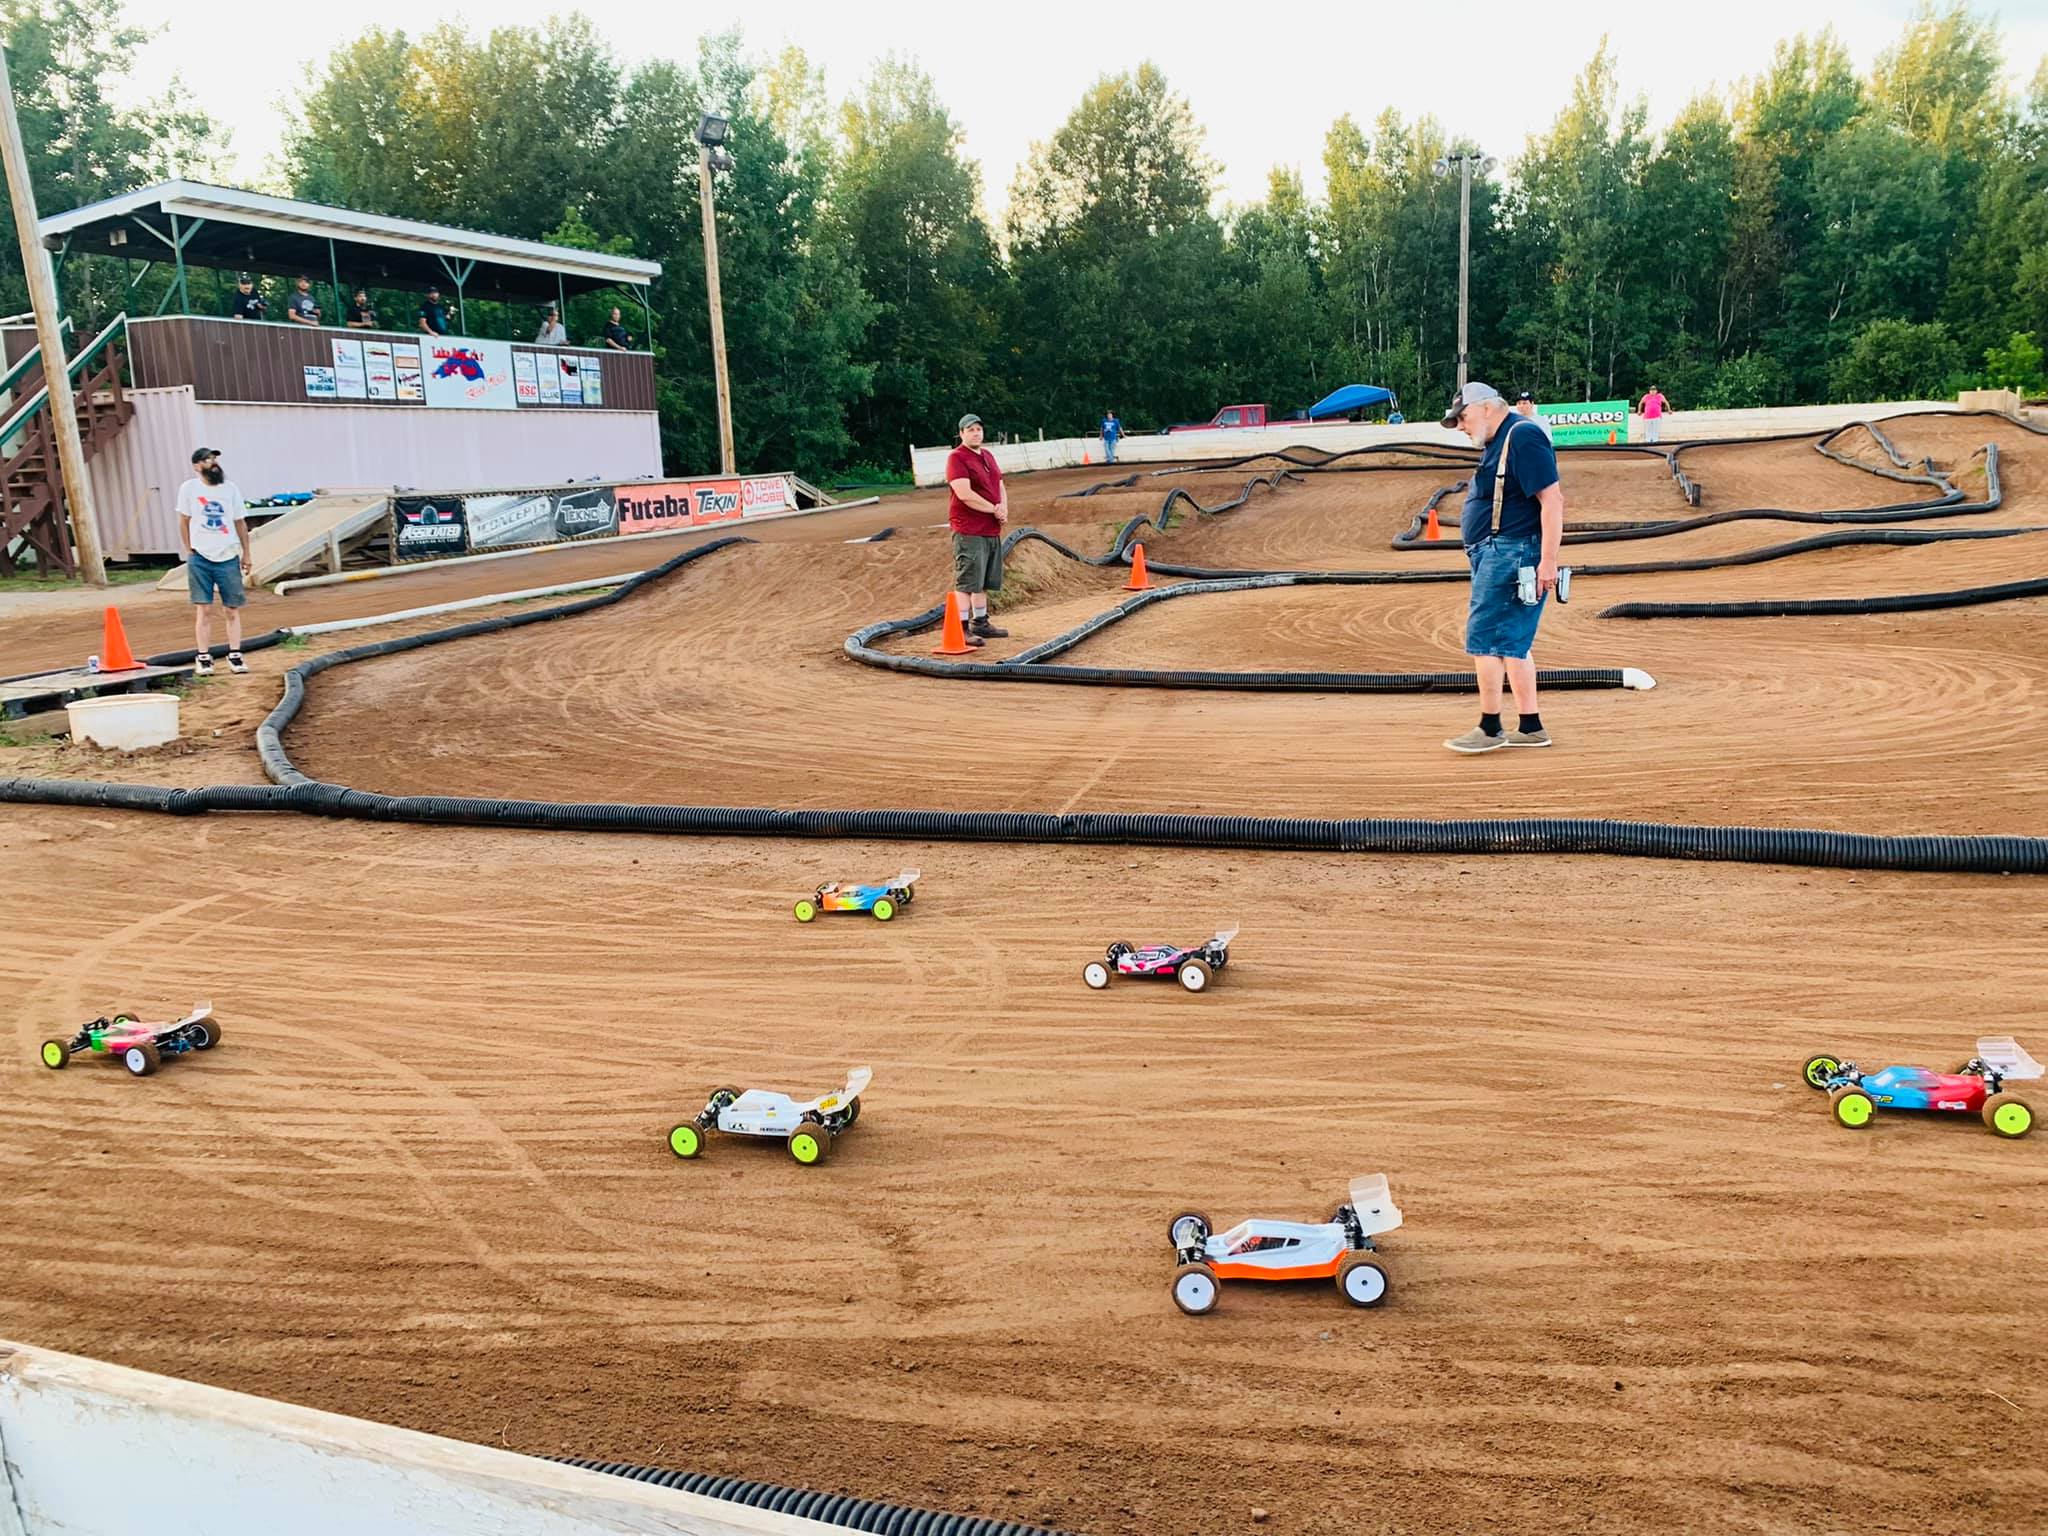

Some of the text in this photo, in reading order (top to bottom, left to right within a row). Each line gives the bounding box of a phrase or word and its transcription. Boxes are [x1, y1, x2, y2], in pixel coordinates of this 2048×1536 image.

[1544, 410, 1625, 426] MENARDS
[618, 495, 689, 521] Futaba
[695, 489, 738, 514] TEKIN
